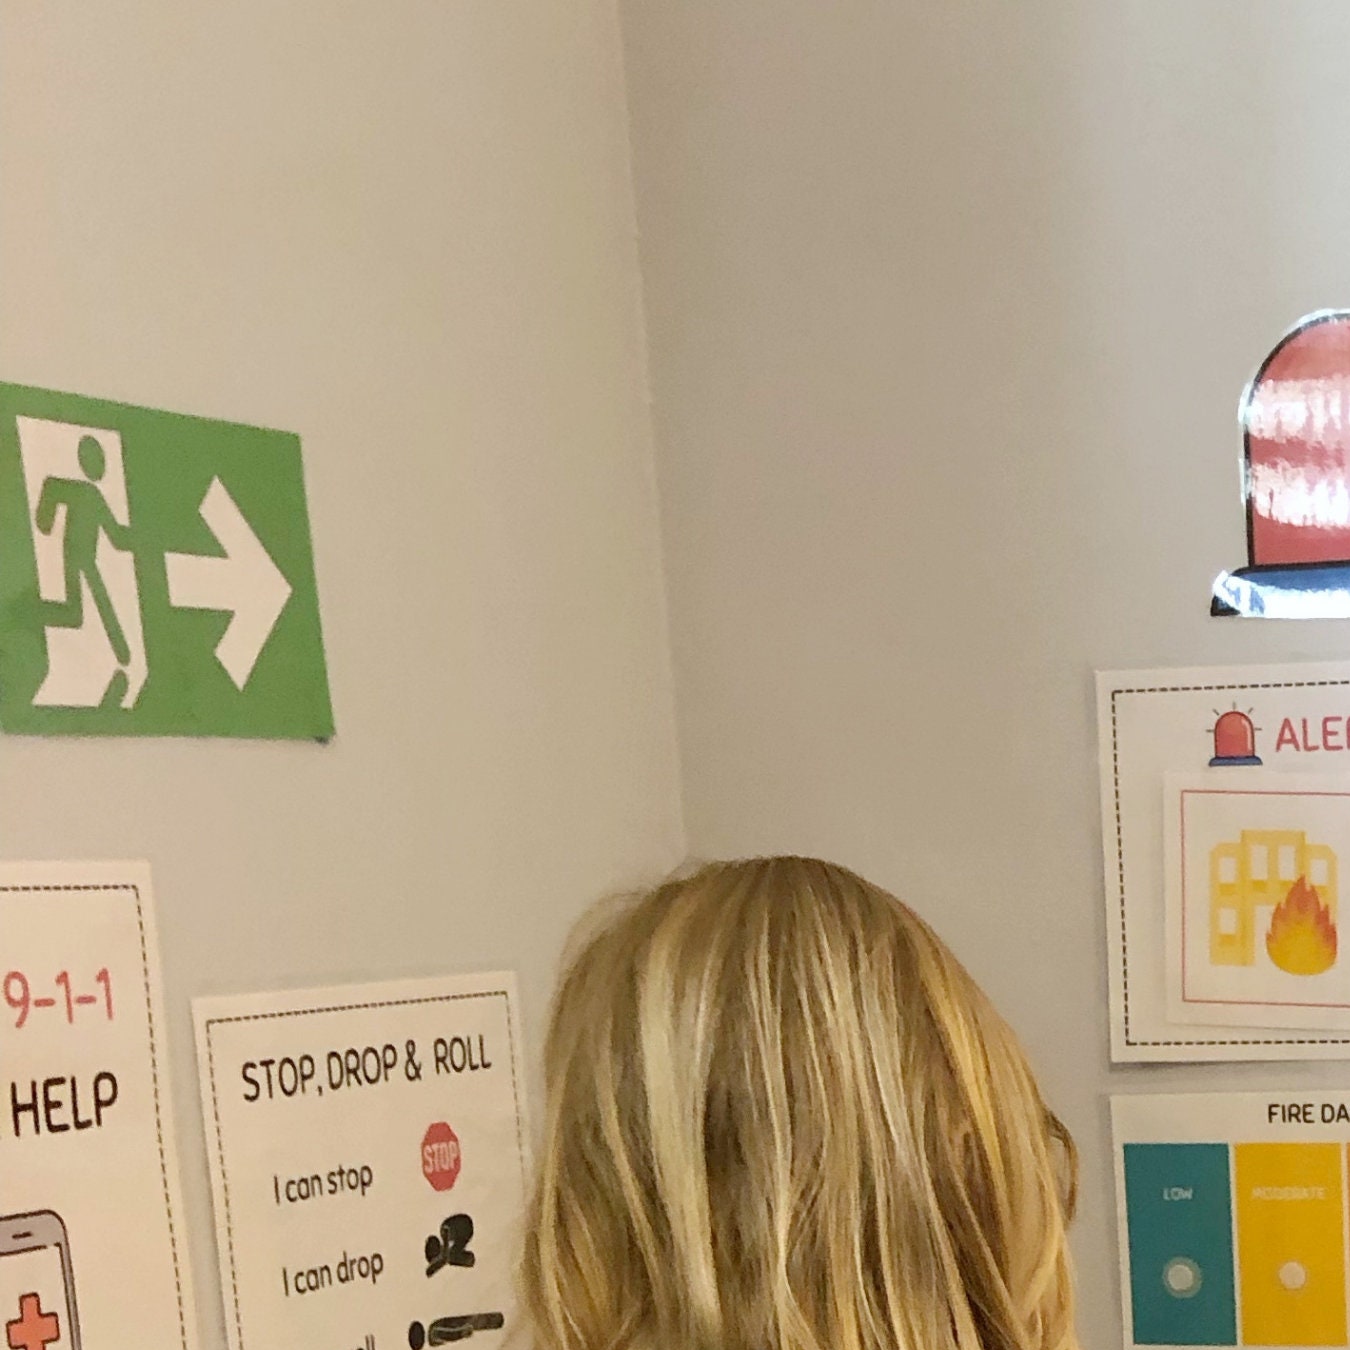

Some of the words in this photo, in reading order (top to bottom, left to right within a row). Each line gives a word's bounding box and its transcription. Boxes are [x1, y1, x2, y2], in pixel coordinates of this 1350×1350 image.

[2, 967, 114, 1029] 9-1-1
[326, 1043, 398, 1091] DROP
[404, 1038, 422, 1082] &
[433, 1033, 492, 1075] ROLL
[10, 1070, 119, 1138] HELP
[1267, 1103, 1315, 1124] FIRE
[423, 1140, 459, 1174] STOP
[273, 1174, 281, 1206] I
[285, 1173, 324, 1203] can
[327, 1163, 374, 1197] stop
[1163, 1187, 1193, 1201] LOW
[282, 1266, 289, 1297] I
[293, 1263, 333, 1295] can
[337, 1250, 384, 1285] drop
